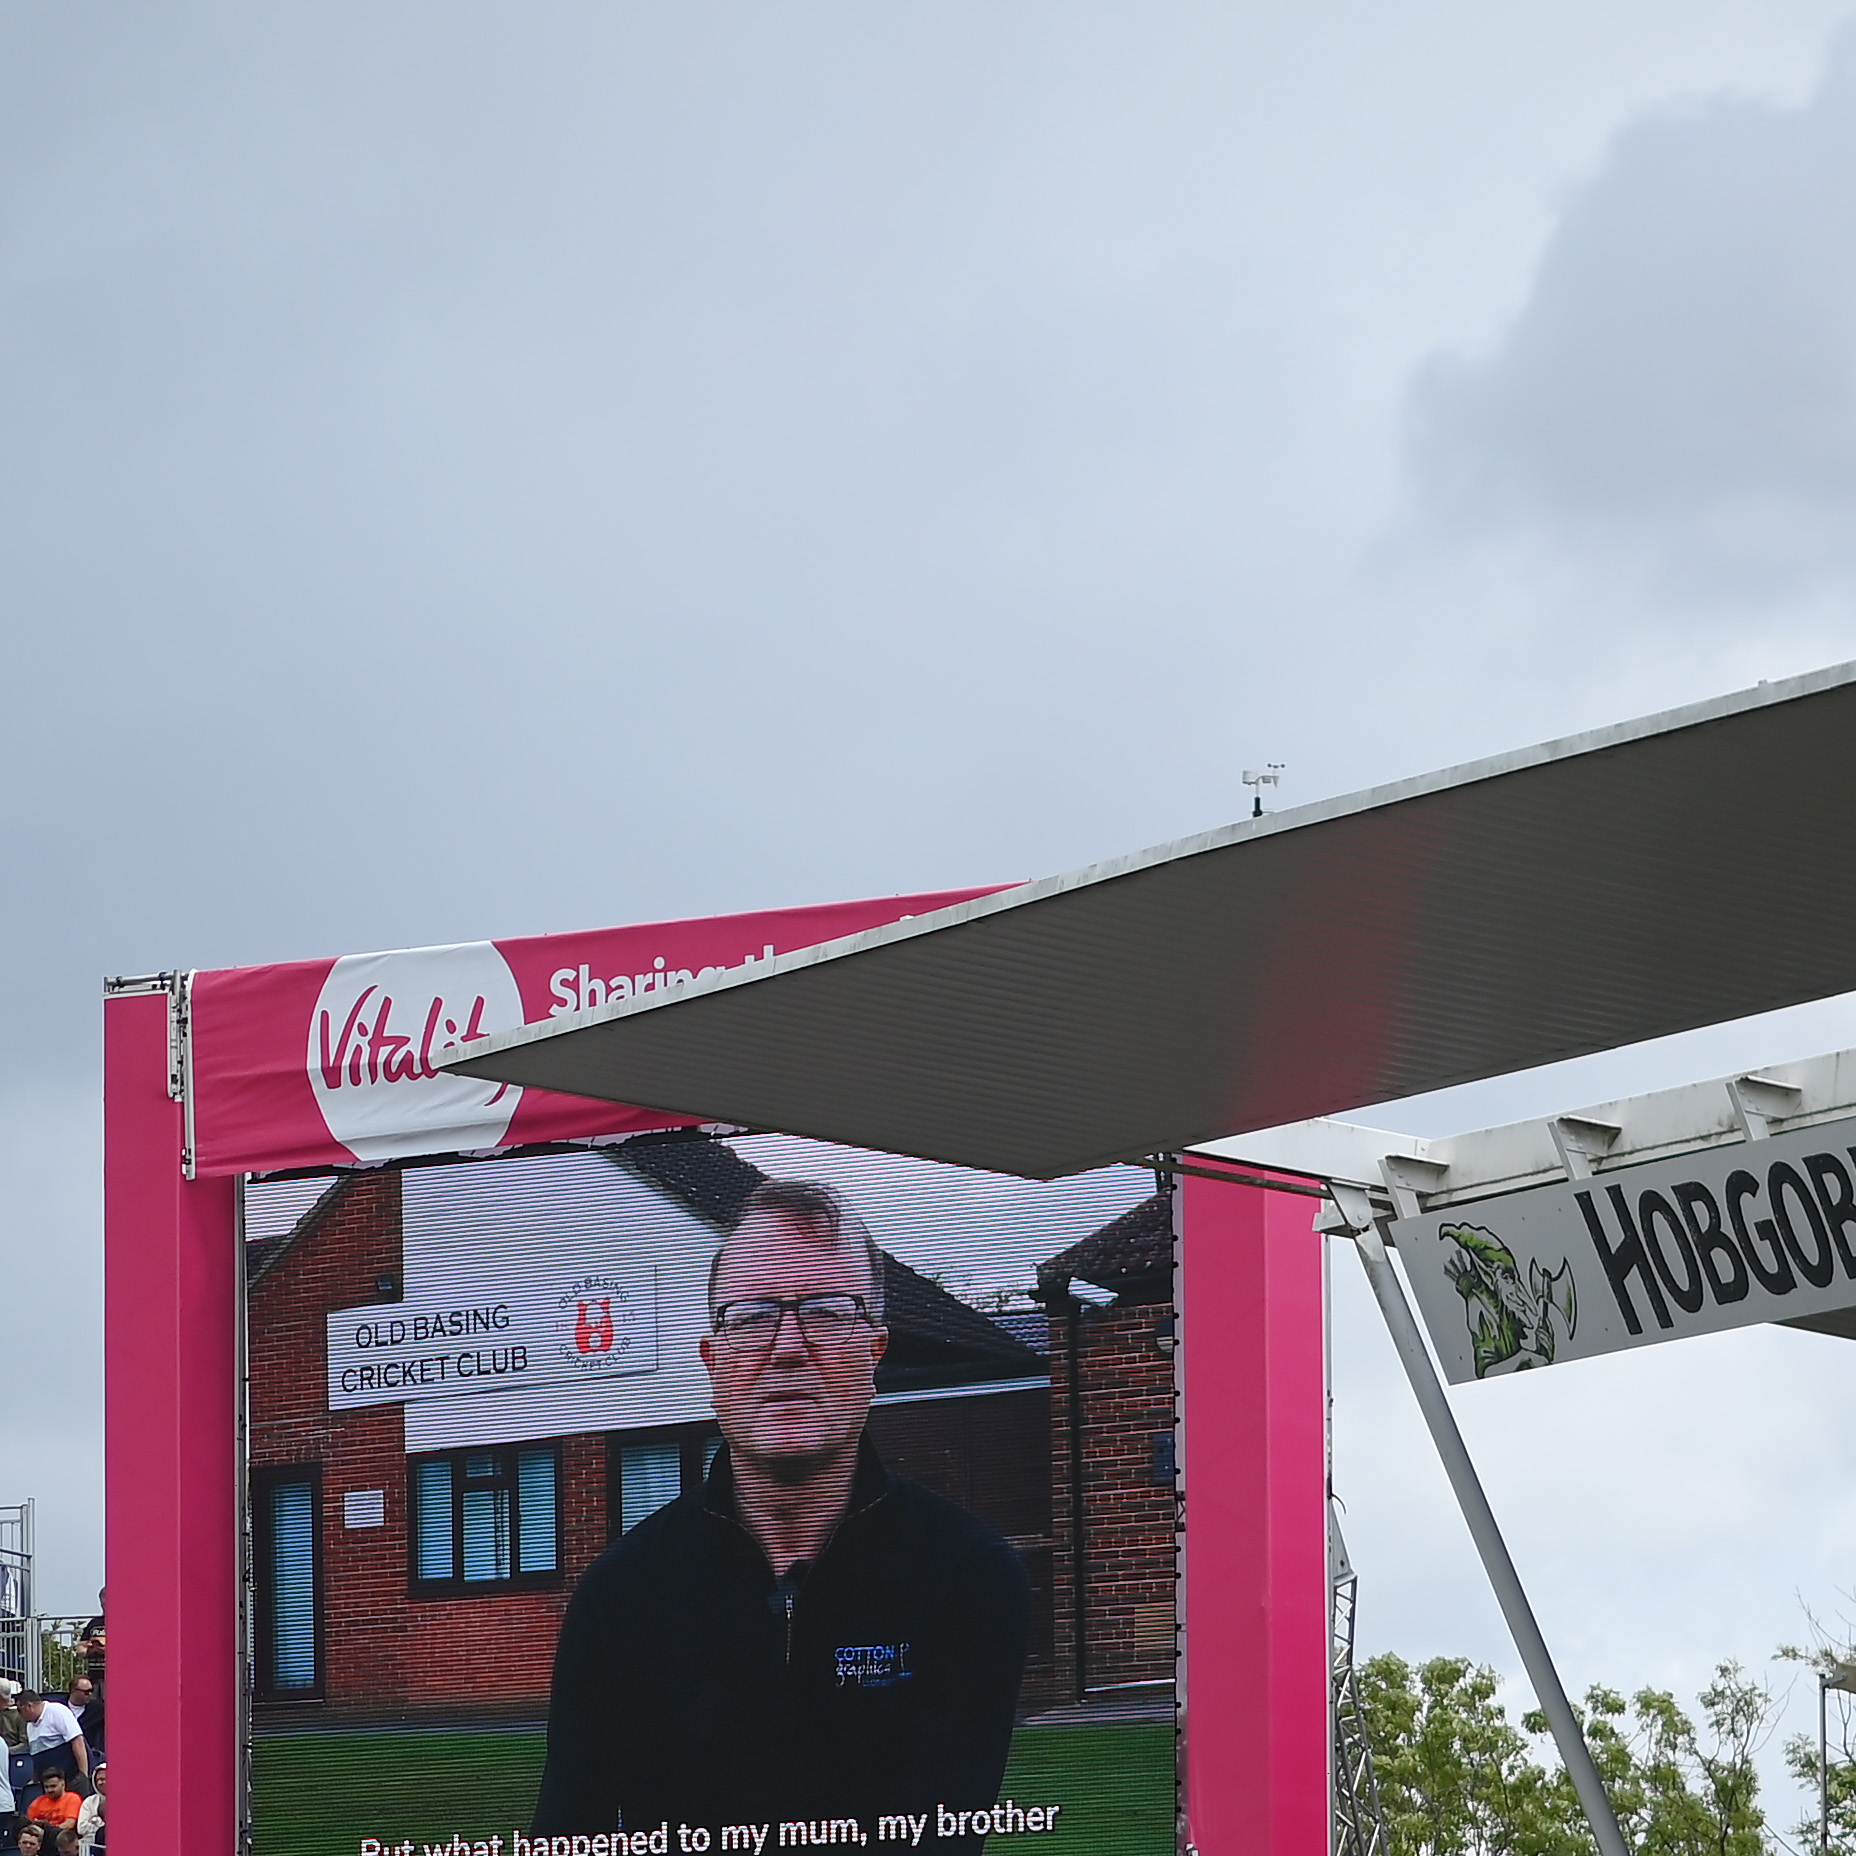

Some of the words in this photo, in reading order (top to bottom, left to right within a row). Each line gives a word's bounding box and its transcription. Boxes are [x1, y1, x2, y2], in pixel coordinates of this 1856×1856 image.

[355, 1320, 406, 1348] OLD
[413, 1304, 510, 1340] BASING
[341, 1356, 451, 1392] CRICKET
[456, 1346, 528, 1378] CLUB
[677, 1823, 711, 1853] to
[721, 1823, 770, 1856] my
[779, 1818, 868, 1847] mum,
[878, 1813, 928, 1846] my
[937, 1799, 1060, 1837] brother
